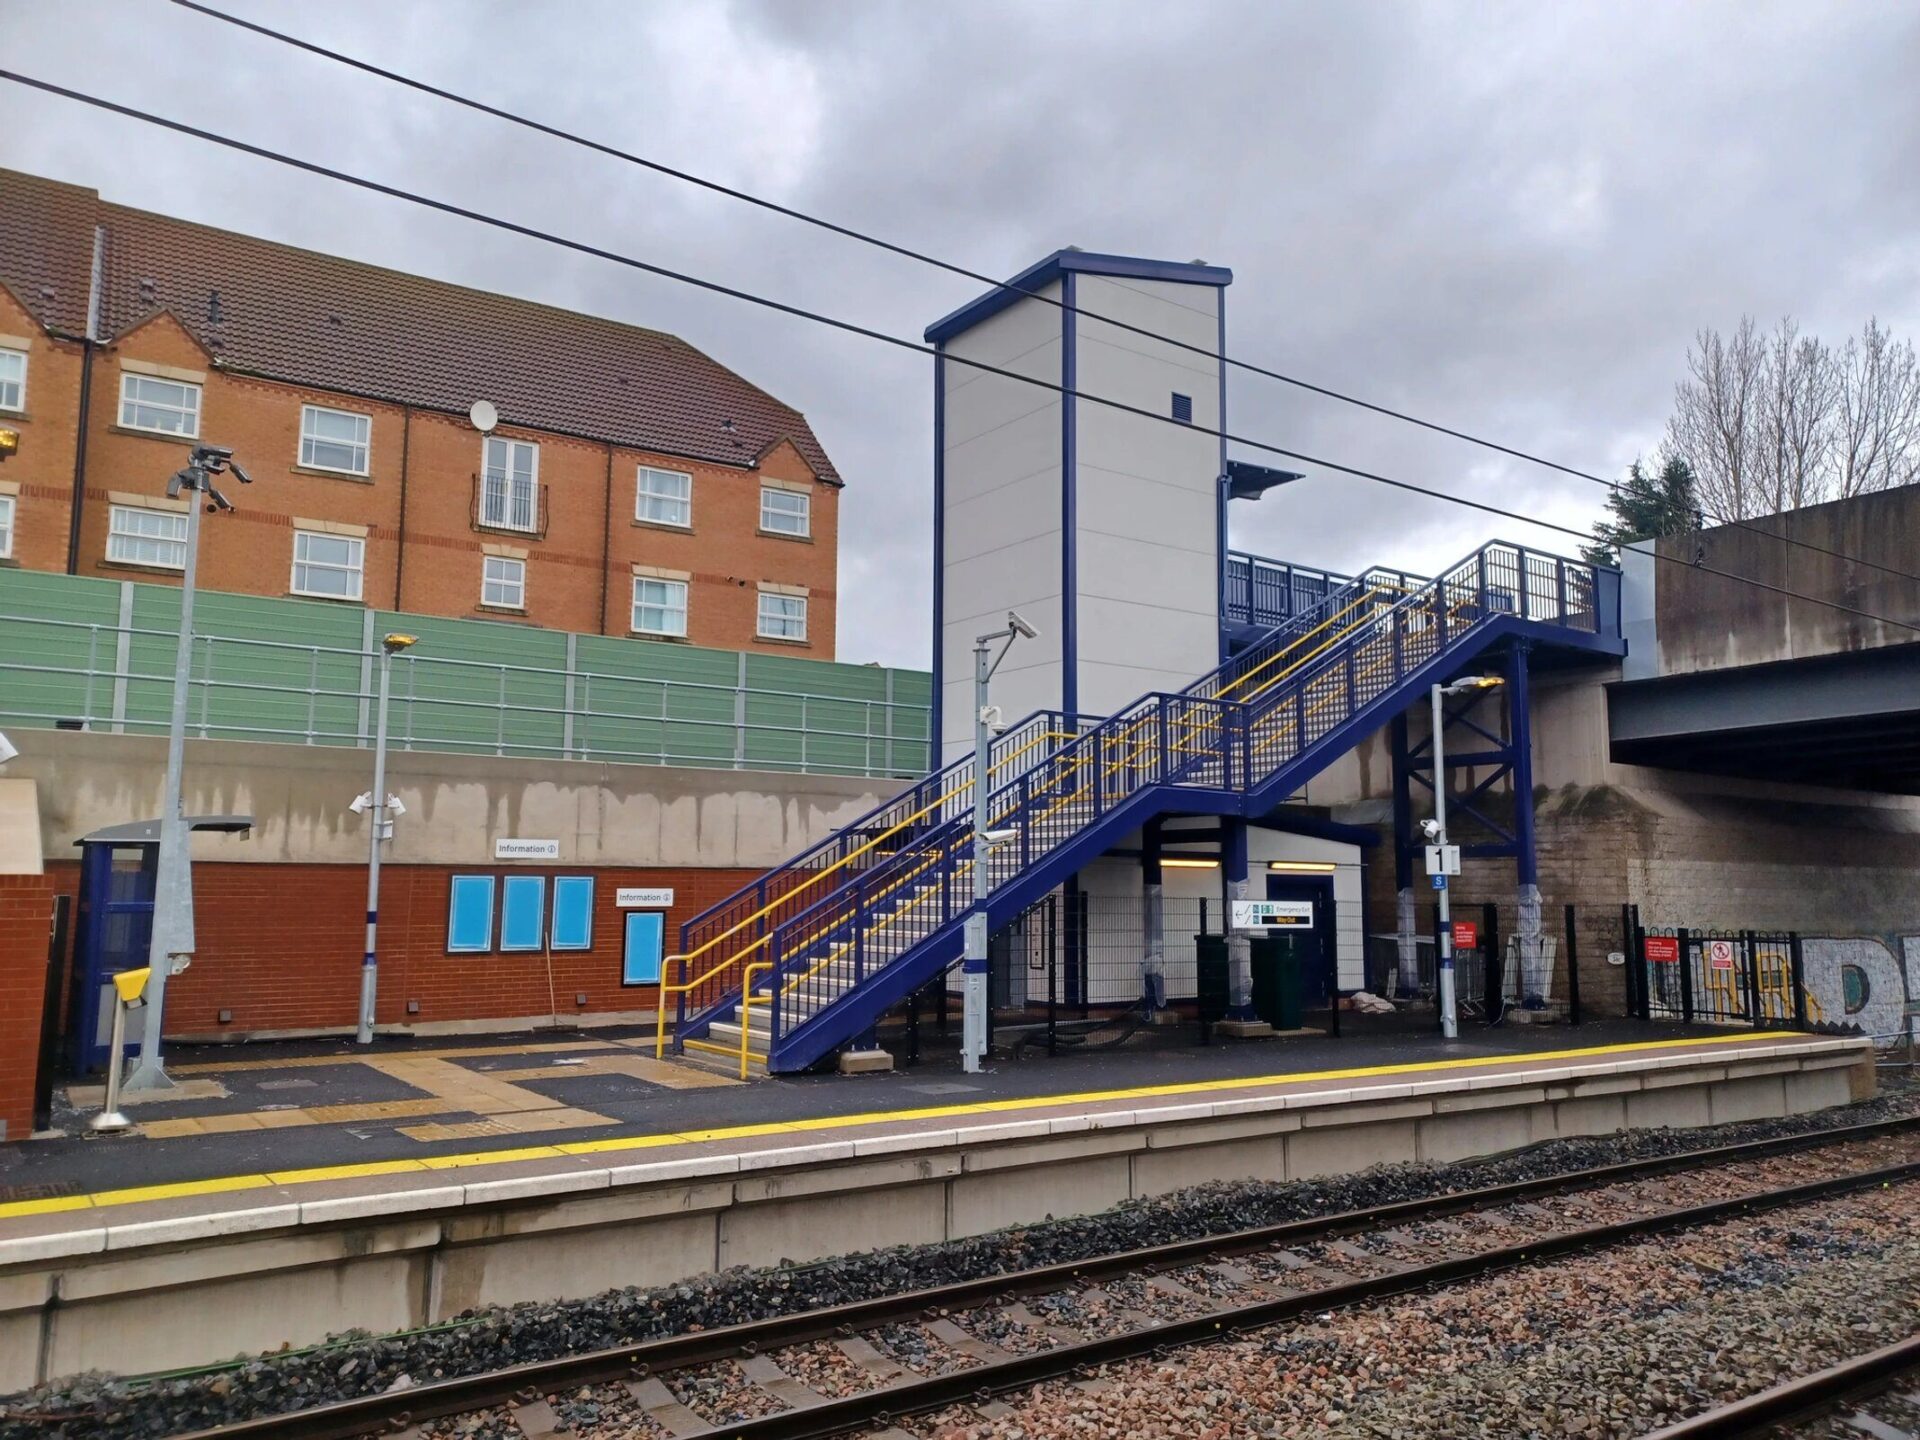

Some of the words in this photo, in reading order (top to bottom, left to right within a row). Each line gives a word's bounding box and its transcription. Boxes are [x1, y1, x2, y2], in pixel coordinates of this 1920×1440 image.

[499, 845, 545, 853] Information
[1435, 848, 1443, 872] 1
[1435, 876, 1442, 886] S
[619, 893, 661, 901] Information
